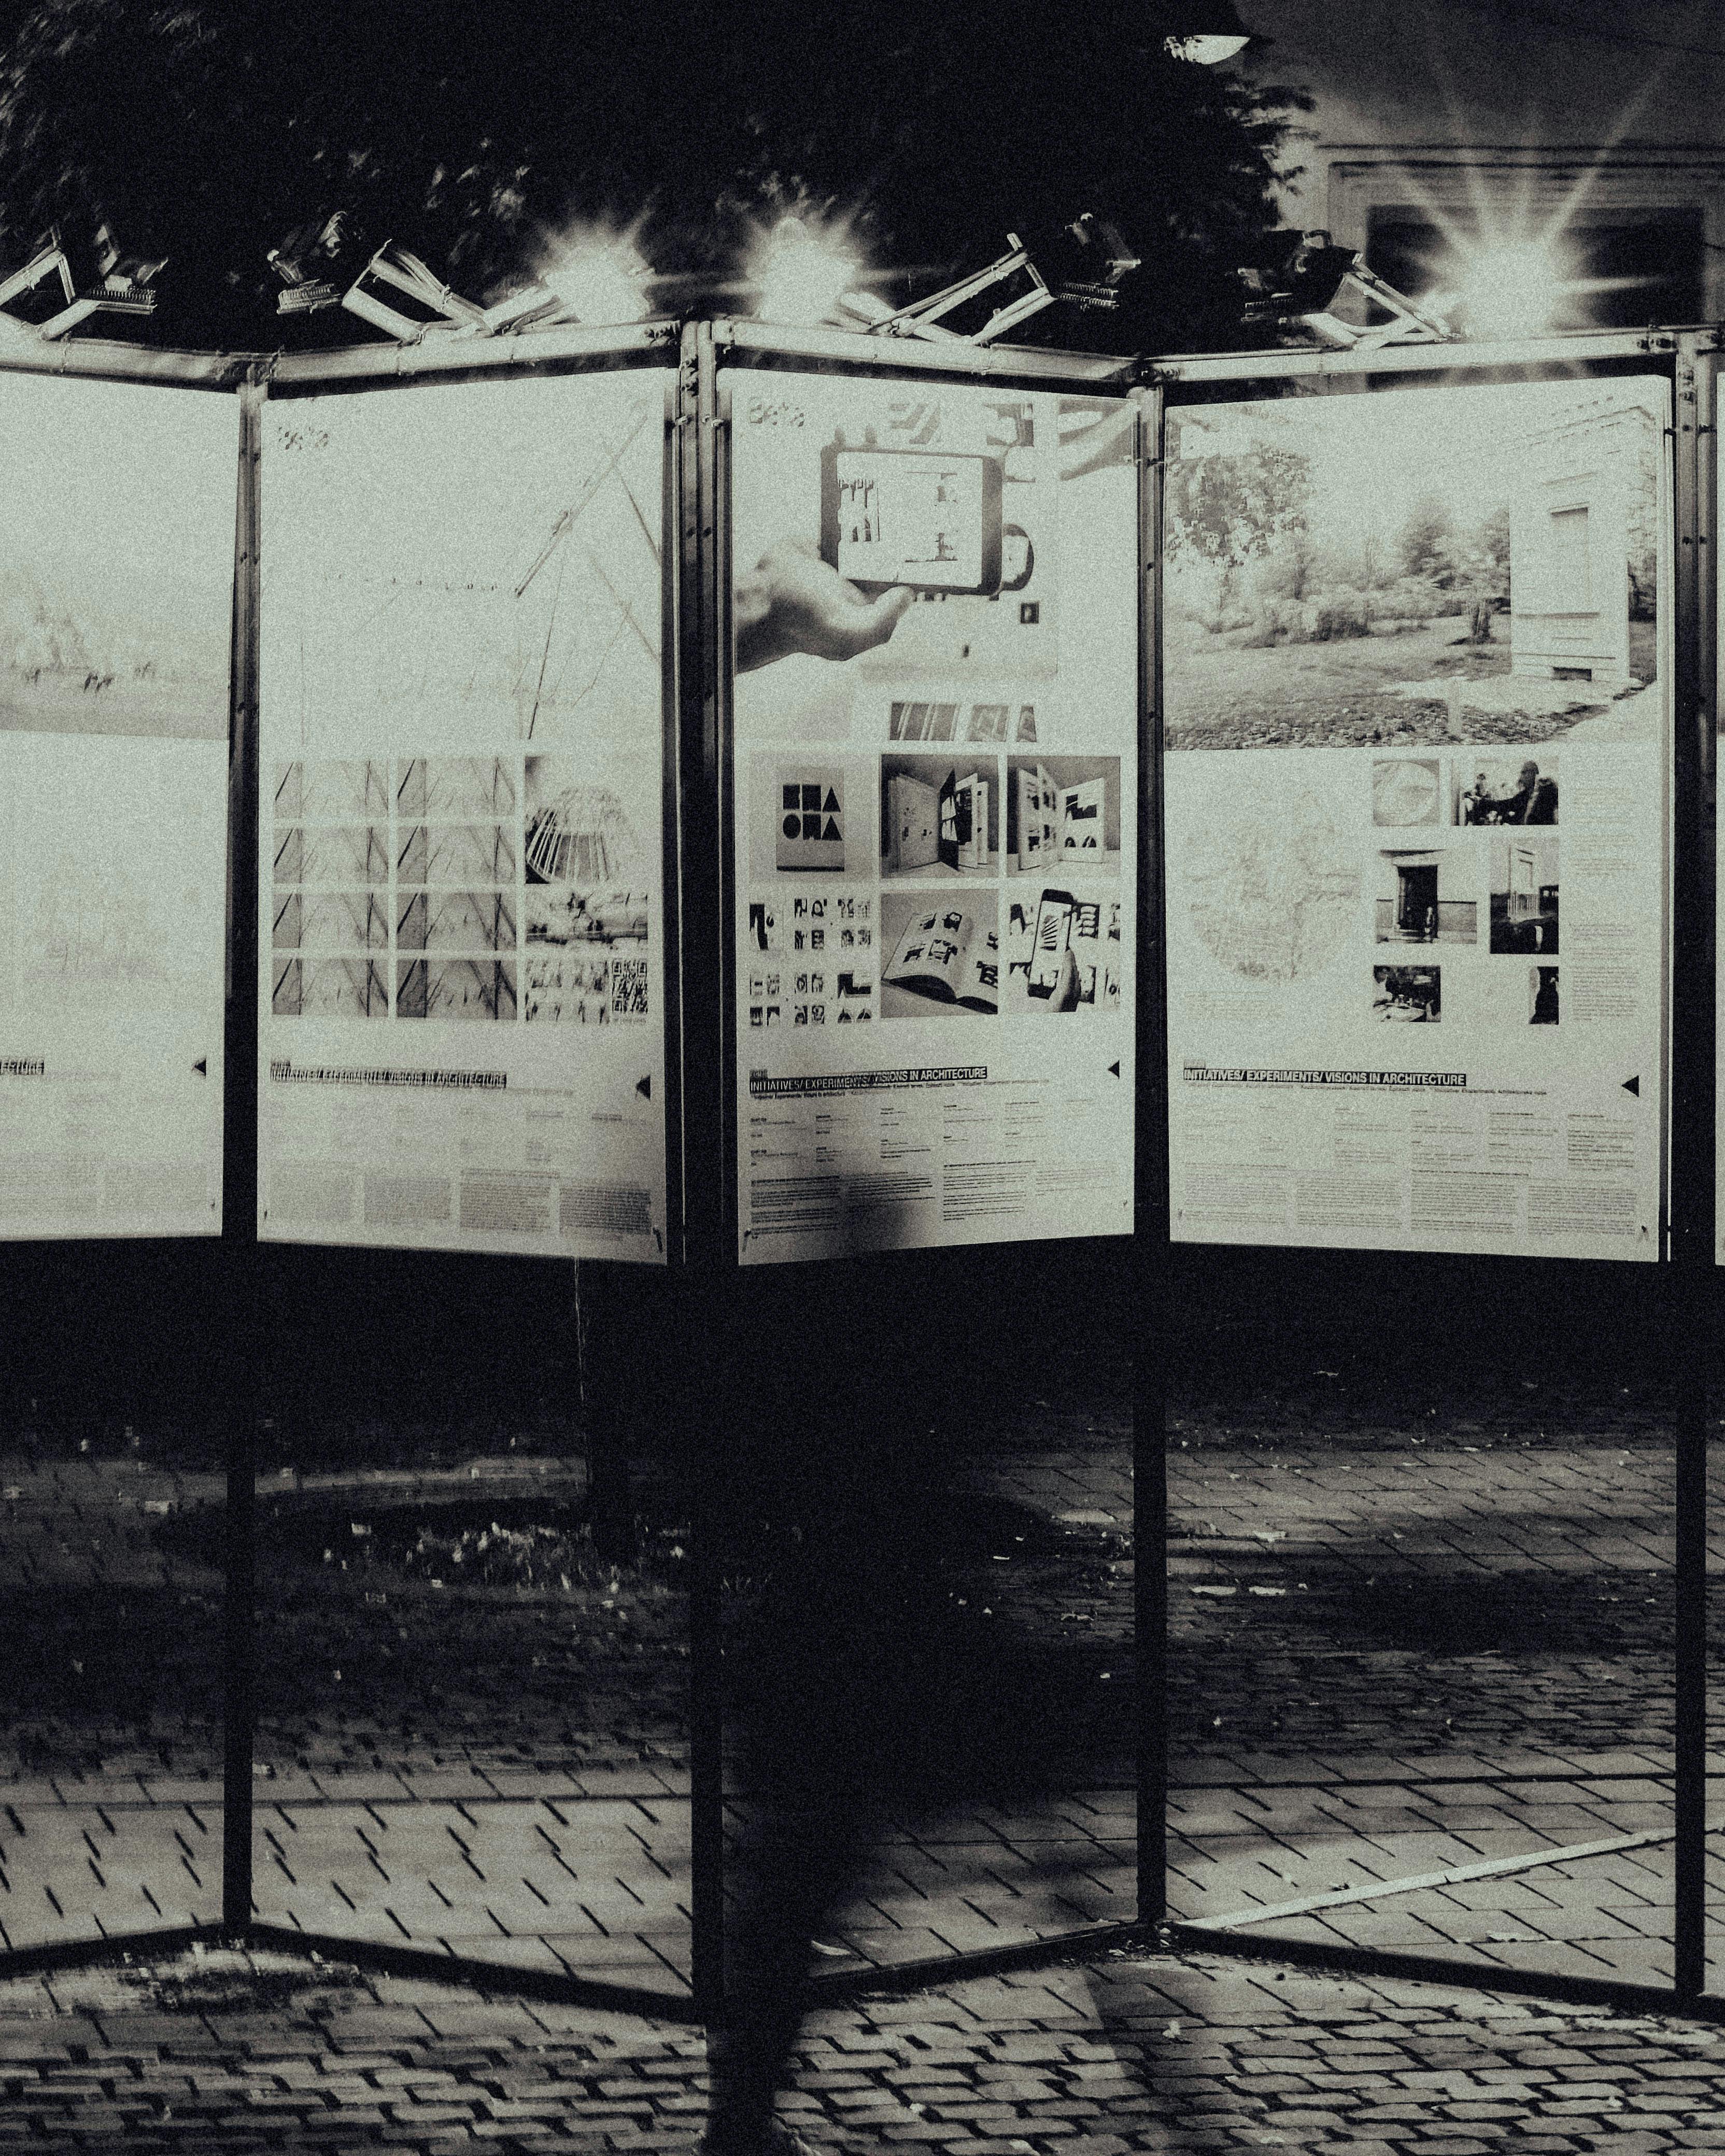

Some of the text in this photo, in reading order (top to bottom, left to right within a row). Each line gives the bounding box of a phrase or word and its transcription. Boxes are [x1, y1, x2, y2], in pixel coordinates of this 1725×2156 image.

[751, 1080, 803, 1091] INITIATIVES/
[910, 1070, 918, 1081] IN
[921, 1068, 986, 1080] ARCHITECTURE
[1184, 1069, 1465, 1085] INITIATIVES/ EXPERIMENTS/ VISIONS IN ARCHITECTURE
